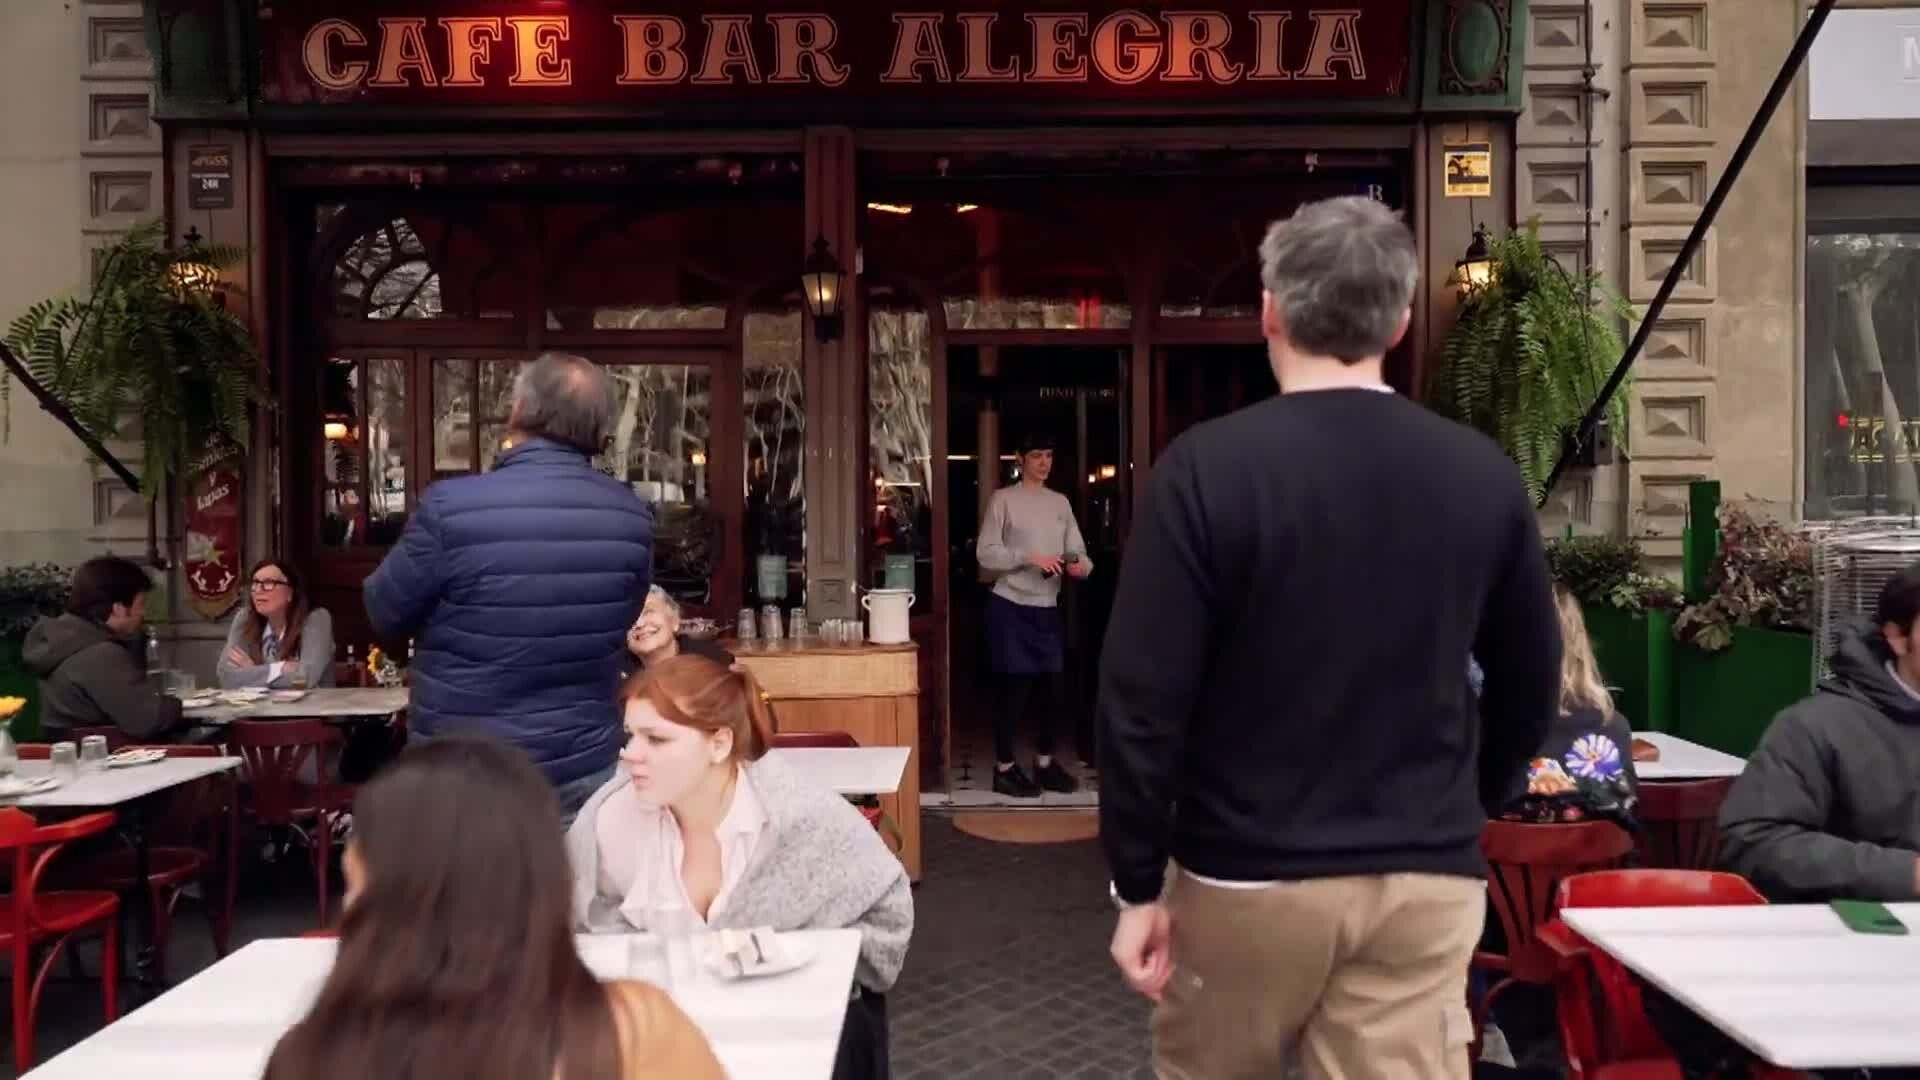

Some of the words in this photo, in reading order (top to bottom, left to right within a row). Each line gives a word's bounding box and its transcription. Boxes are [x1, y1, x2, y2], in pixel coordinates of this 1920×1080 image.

[302, 16, 572, 90] CAFE
[613, 14, 851, 87] BAR
[880, 9, 1366, 85] ALEGRIA
